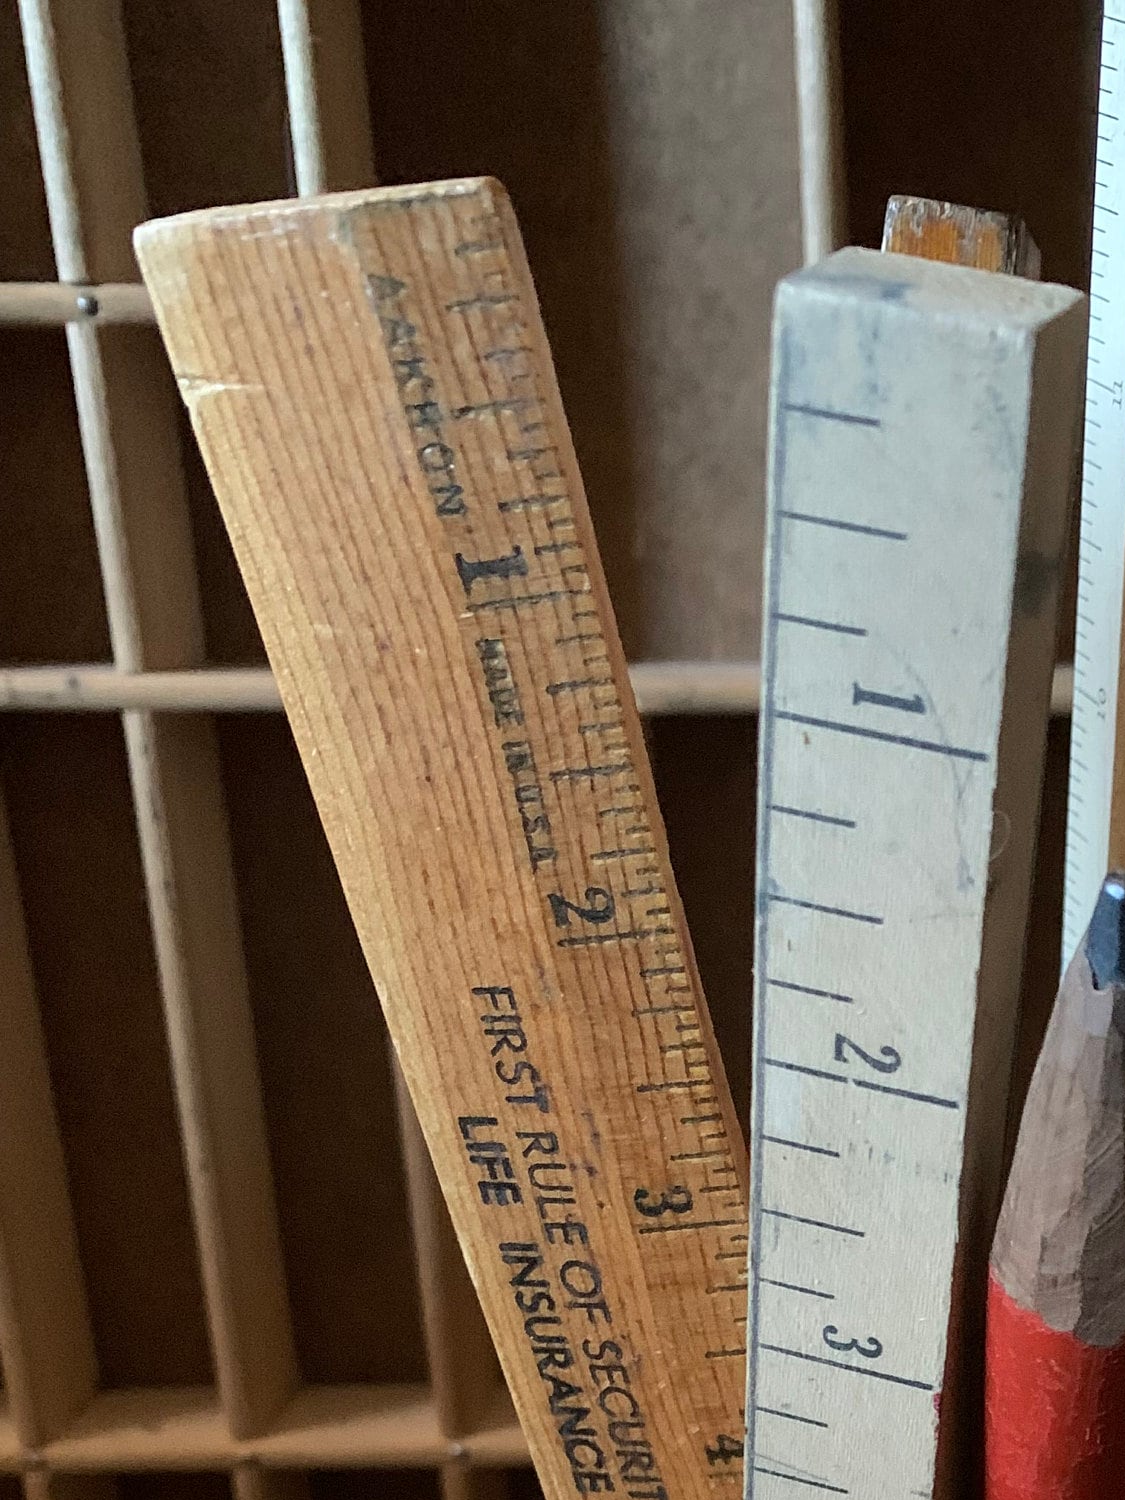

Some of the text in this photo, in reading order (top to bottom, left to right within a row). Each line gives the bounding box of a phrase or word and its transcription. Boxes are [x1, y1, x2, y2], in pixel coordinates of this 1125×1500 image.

[455, 544, 529, 594] 1
[851, 681, 926, 715] 1
[547, 886, 615, 928] 2
[834, 1032, 901, 1075] 2
[471, 985, 550, 1114] FIRST
[514, 1130, 588, 1246] RULE
[559, 1259, 613, 1325] OF
[633, 1184, 694, 1218] 3
[458, 1115, 616, 1497] LIFE INSURANCE
[822, 1323, 883, 1359] 3
[705, 1433, 745, 1466] 4
